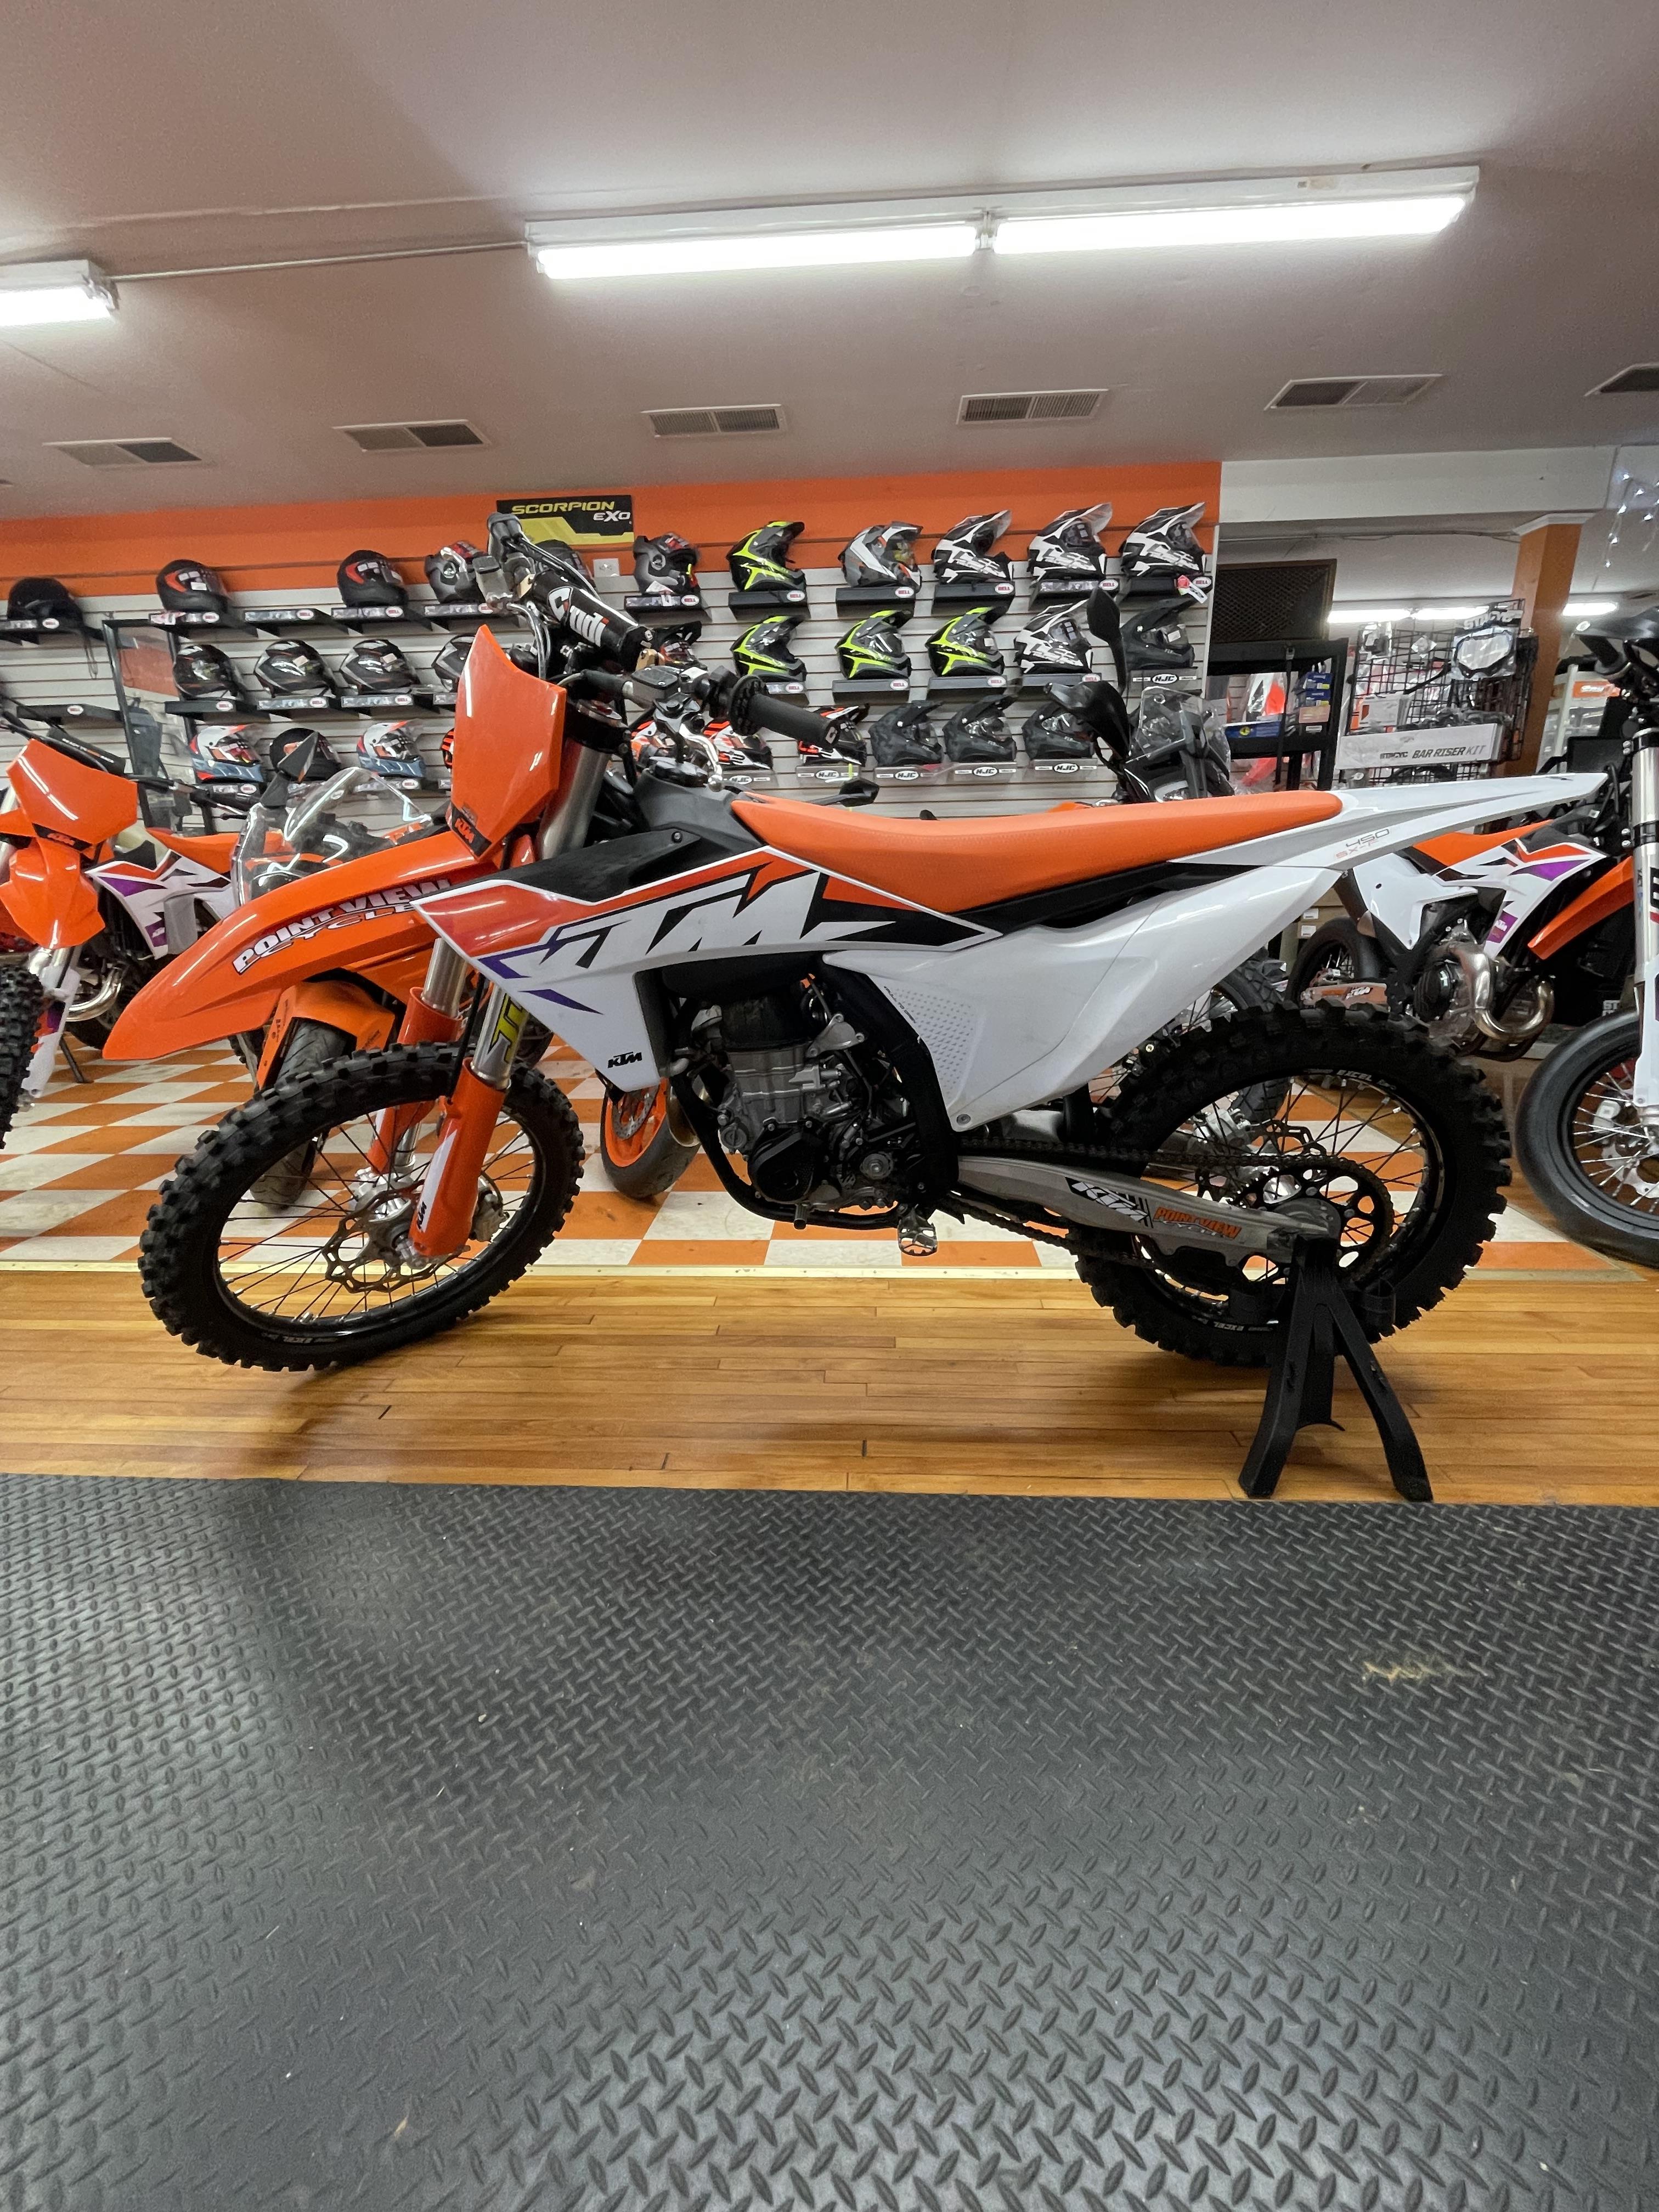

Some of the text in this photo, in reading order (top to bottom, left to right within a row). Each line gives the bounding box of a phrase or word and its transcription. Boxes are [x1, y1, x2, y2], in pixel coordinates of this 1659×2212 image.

[511, 501, 615, 515] SCORPION
[1412, 749, 1432, 759] BAR
[1434, 747, 1466, 758] RISER
[1465, 745, 1487, 756] KIT
[1346, 828, 1390, 847] 450
[232, 878, 451, 975] POINT VIEW
[607, 1051, 642, 1069] KTM
[1153, 1207, 1198, 1223] POINT
[1198, 1217, 1242, 1240] VIEW
